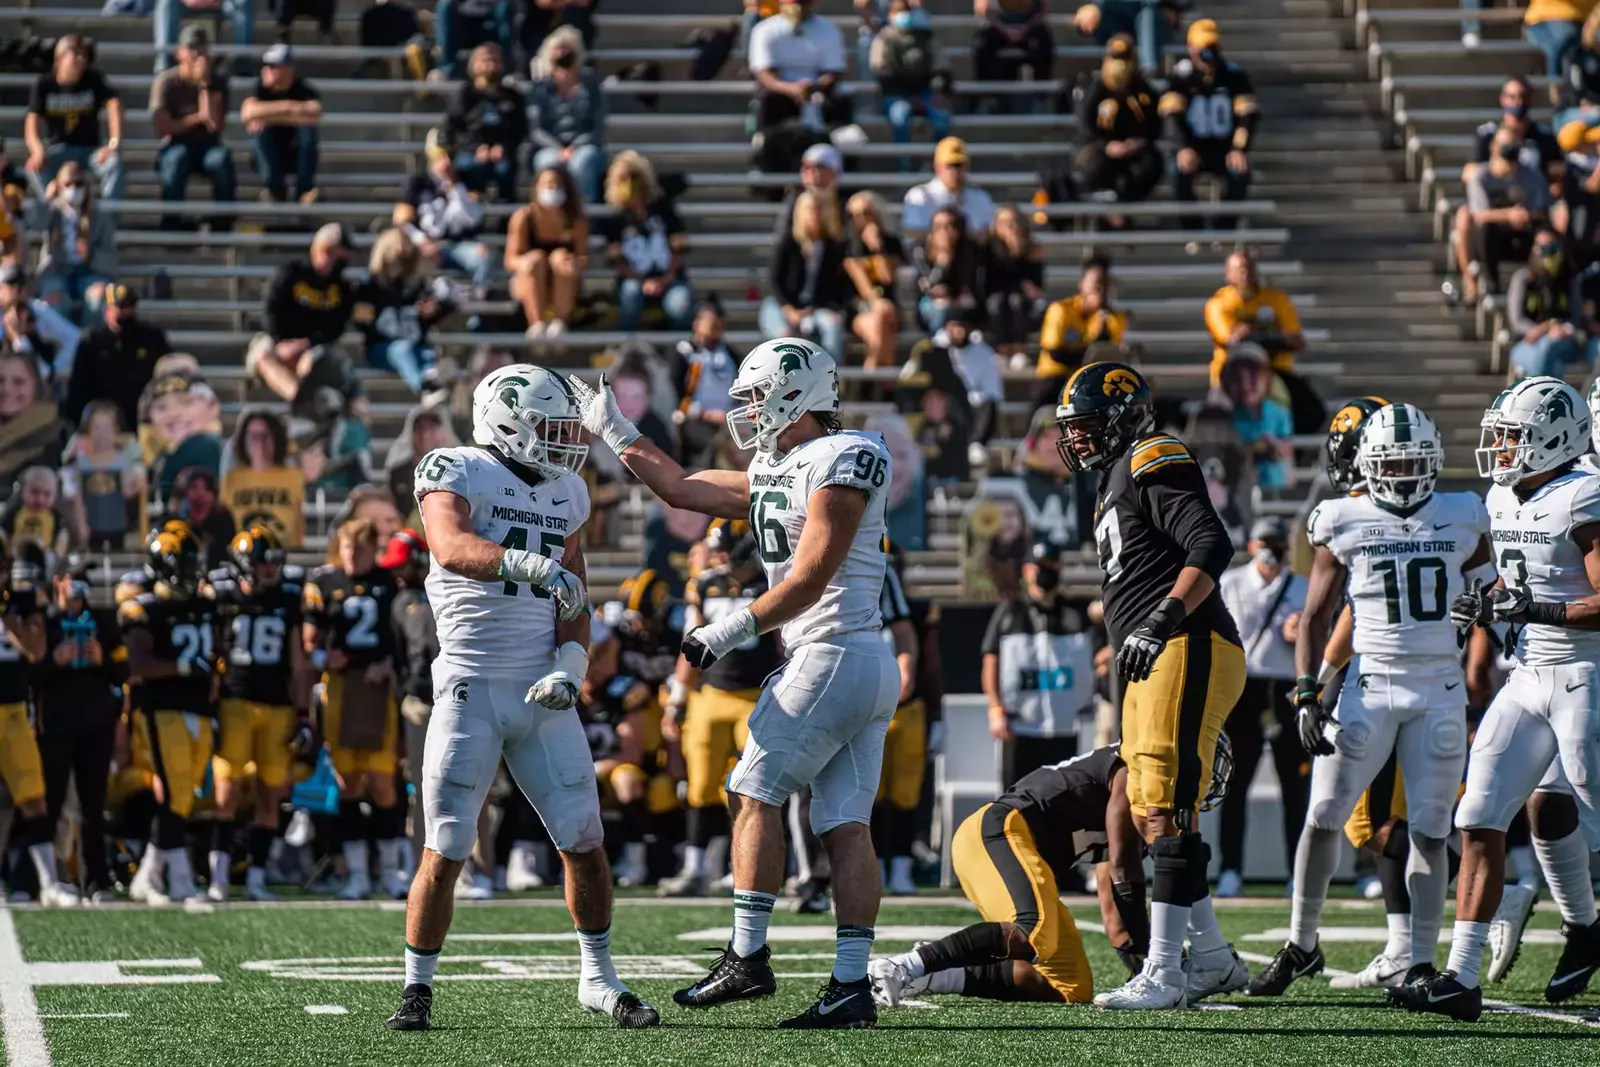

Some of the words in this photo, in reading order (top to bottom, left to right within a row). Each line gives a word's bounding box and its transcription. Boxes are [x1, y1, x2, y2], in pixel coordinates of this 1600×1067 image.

[1186, 94, 1234, 139] 40
[417, 453, 455, 481] 45
[853, 449, 888, 488] 96
[491, 505, 544, 527] MICHIGAN
[545, 515, 569, 532] STATE
[1522, 531, 1552, 544] STATE
[1095, 506, 1123, 583] 7
[1361, 541, 1421, 556] MICHIGAN
[1423, 541, 1456, 553] STATE
[1371, 556, 1449, 624] 10
[1500, 548, 1534, 605] 3
[229, 614, 285, 665] 16
[343, 596, 379, 647] 2
